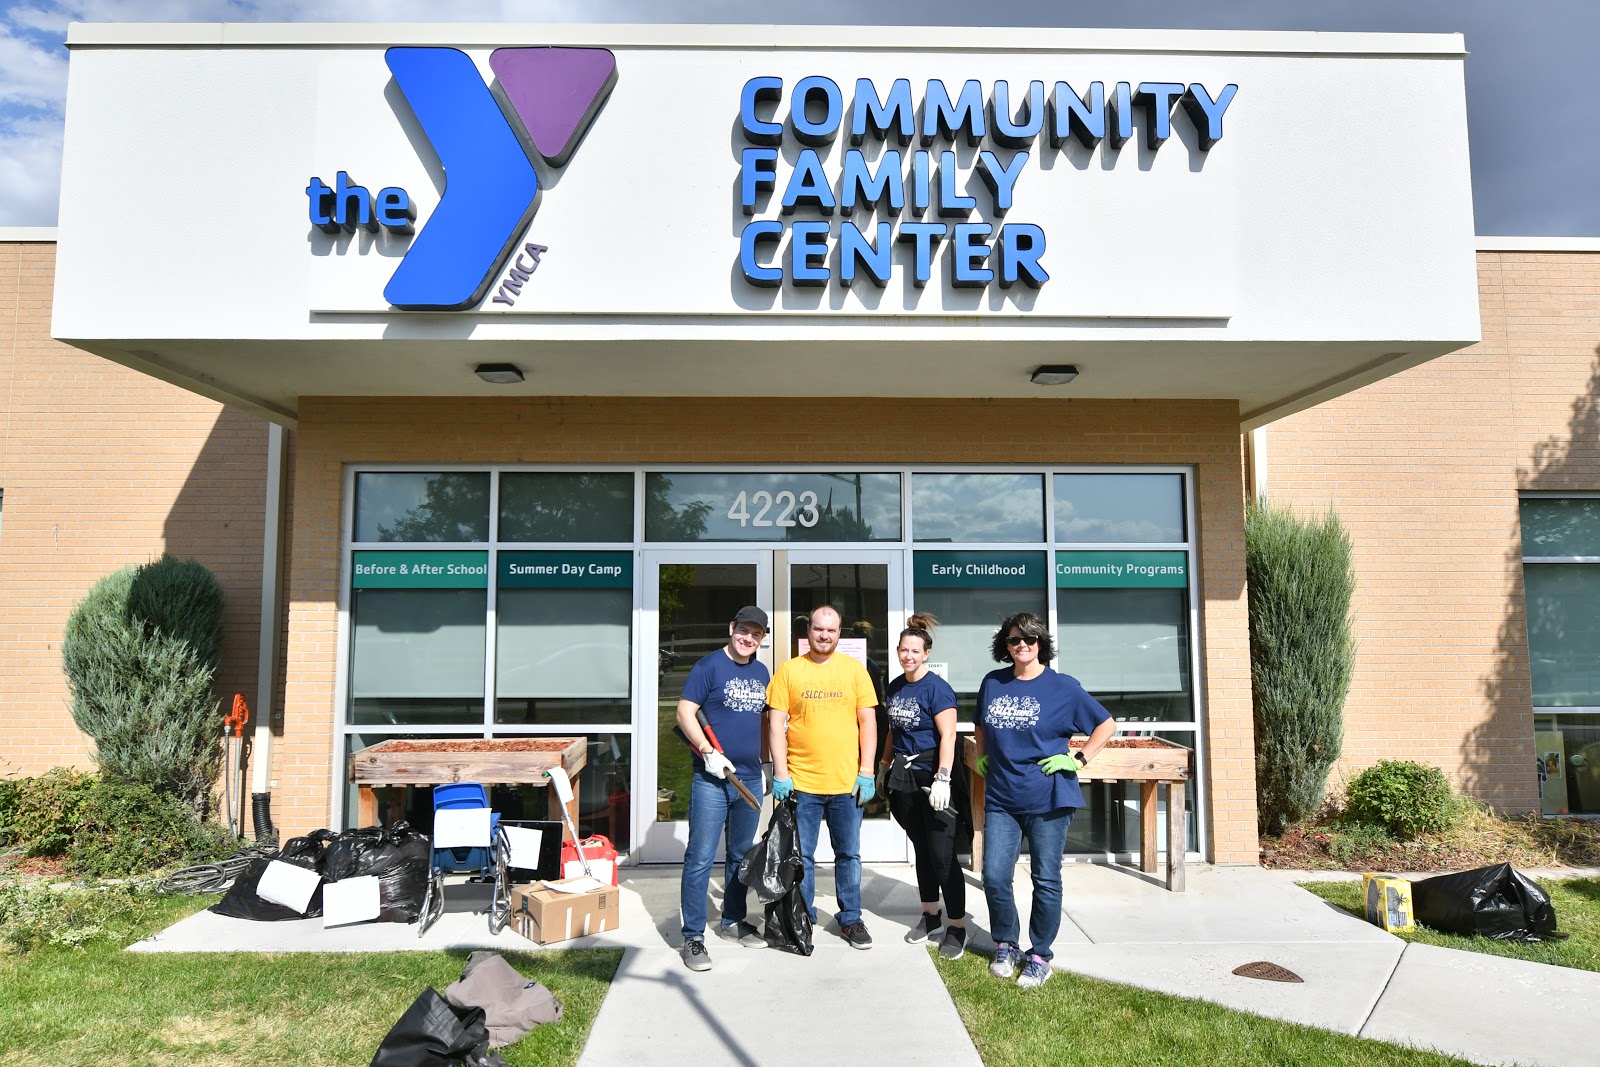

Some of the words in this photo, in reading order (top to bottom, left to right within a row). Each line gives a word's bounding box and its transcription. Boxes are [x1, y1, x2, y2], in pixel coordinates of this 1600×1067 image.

[740, 75, 1239, 142] COMMUNITY
[306, 171, 410, 226] the
[741, 148, 1030, 210] FAMILY
[492, 242, 548, 306] YMCA
[740, 220, 1050, 284] CENTER
[727, 490, 820, 528] 4223
[355, 563, 397, 575] Before
[399, 563, 409, 575] &
[411, 563, 444, 575] After
[446, 563, 487, 575] School
[509, 564, 558, 576] Summer
[562, 564, 584, 579] Day
[588, 564, 622, 579] Camp
[932, 564, 962, 577] Early
[966, 564, 1026, 576] Childhood
[1056, 564, 1122, 577] Community
[1126, 564, 1184, 577] Programs
